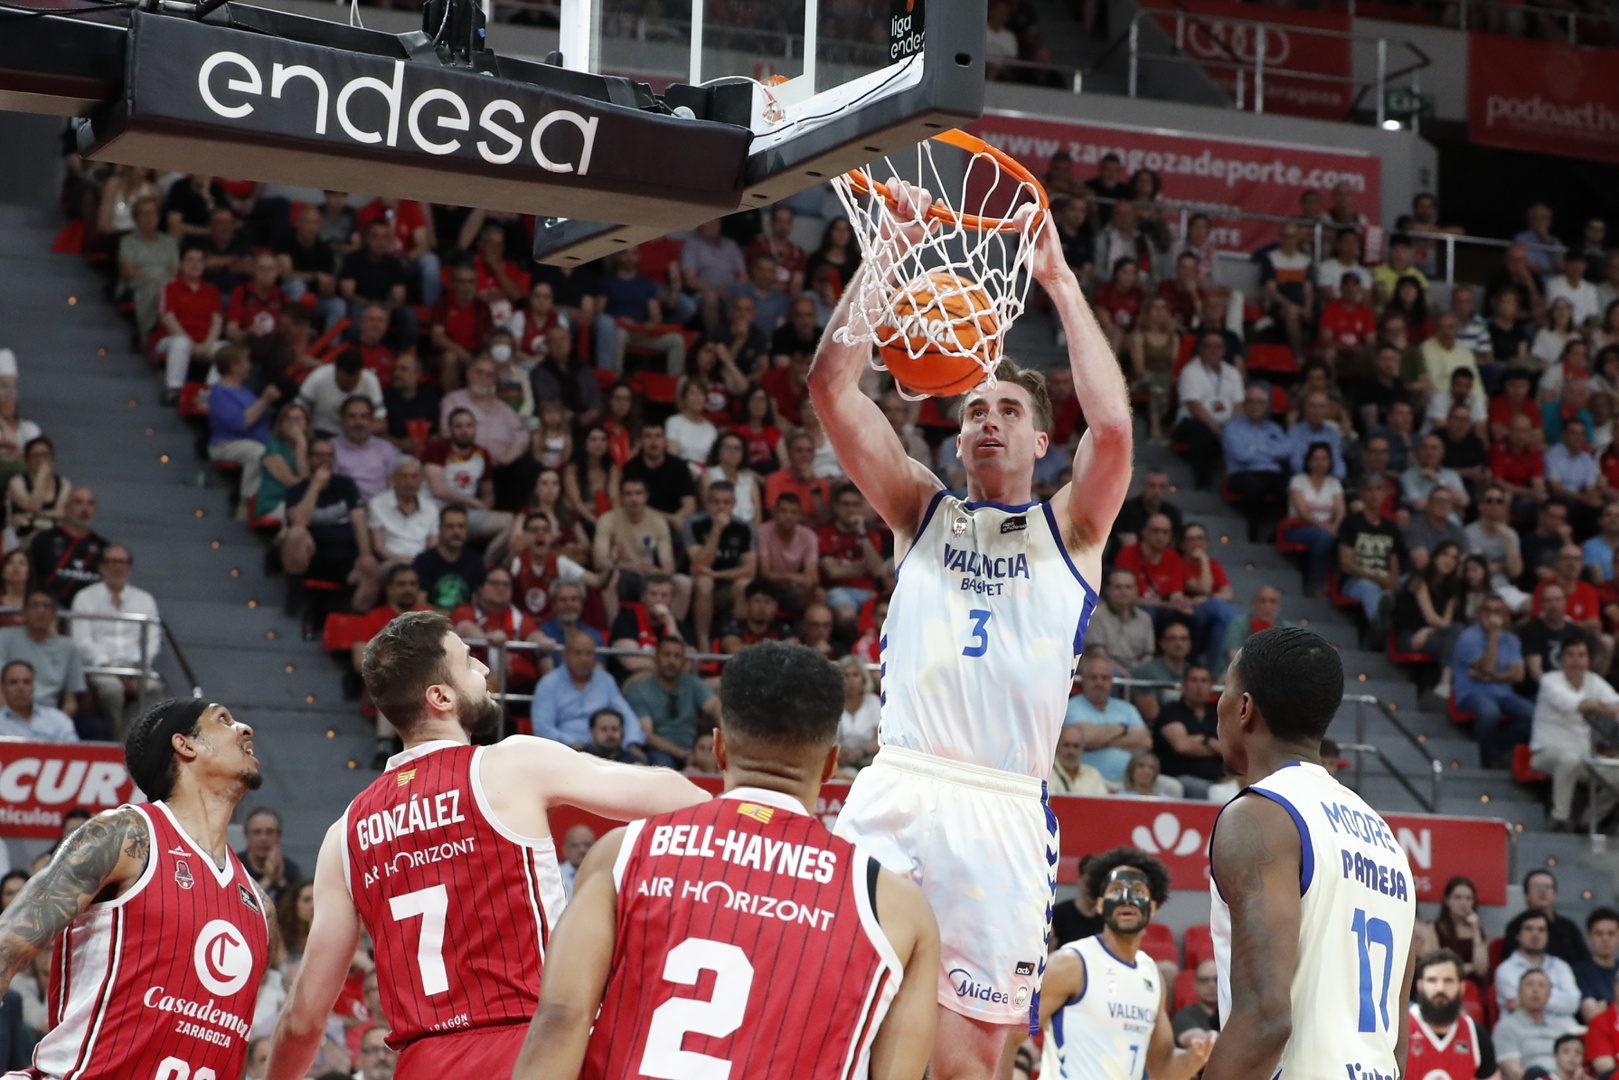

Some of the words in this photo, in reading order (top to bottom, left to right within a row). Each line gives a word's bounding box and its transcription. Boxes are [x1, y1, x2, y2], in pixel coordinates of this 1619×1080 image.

[891, 15, 912, 38] liga
[199, 51, 599, 176] endesa
[979, 131, 1366, 193] wwwzaragozadeporte.com
[962, 609, 992, 657] 3
[0, 757, 148, 806] CUR
[356, 789, 465, 851] GONZÁLEZ
[1320, 801, 1396, 854] MOORE
[364, 865, 380, 889] AR
[384, 837, 475, 877] HORIZONT
[650, 825, 837, 884] BELL-HAYNES
[1341, 848, 1408, 902] PAMESA
[638, 877, 675, 897] AIR
[681, 880, 835, 931] HORIZONT
[389, 884, 449, 996] 7
[637, 937, 755, 1080] 2
[957, 979, 1009, 1004] Midea
[175, 1020, 232, 1048] ZARAGOZA
[1129, 1045, 1139, 1076] 7
